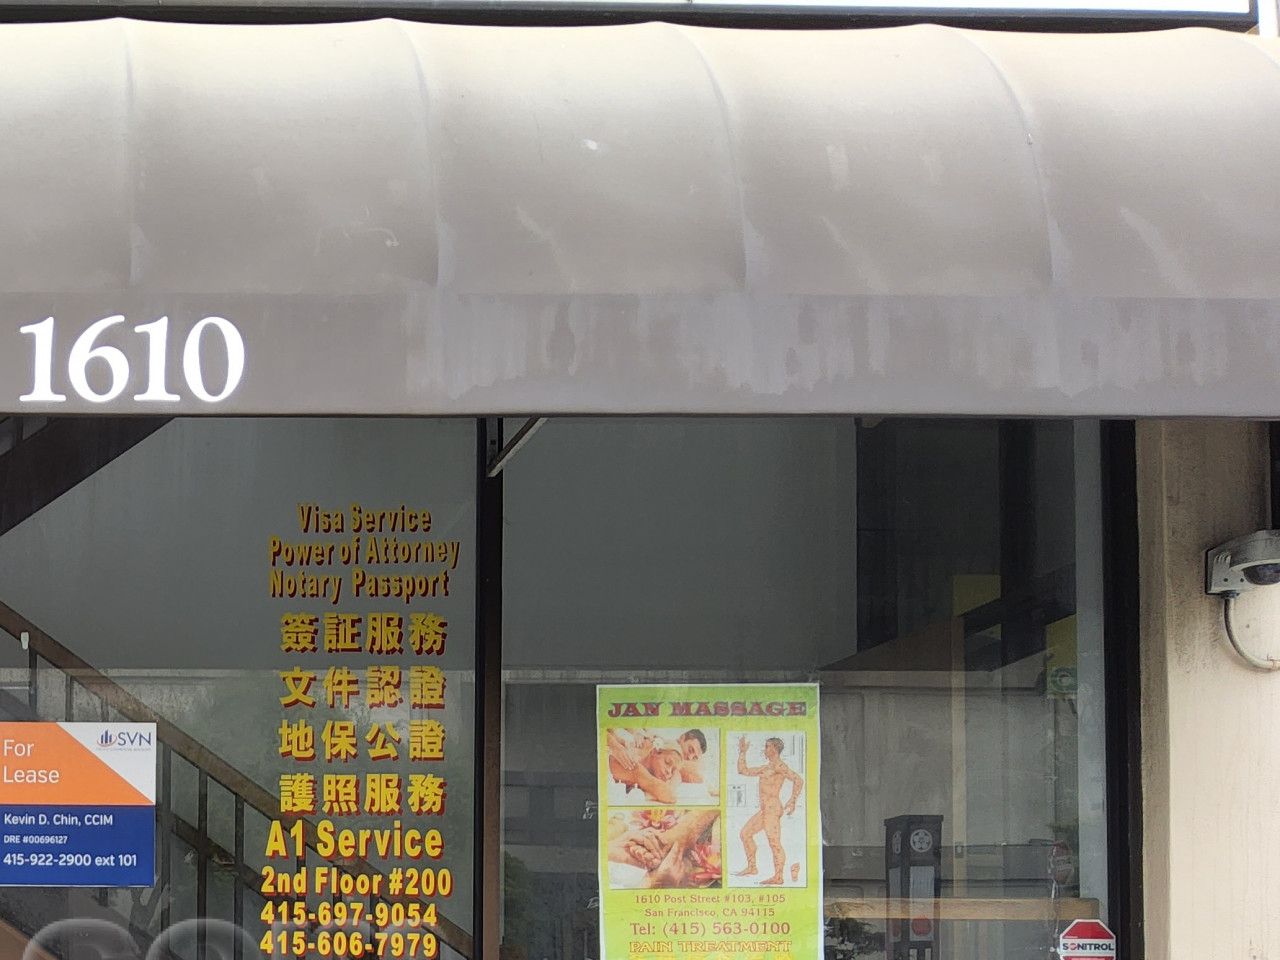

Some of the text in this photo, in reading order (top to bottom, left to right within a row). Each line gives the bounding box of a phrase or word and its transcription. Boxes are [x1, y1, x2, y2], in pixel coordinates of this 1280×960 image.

[19, 314, 245, 403] 1610
[297, 504, 432, 533] Visa Service
[270, 535, 461, 569] Power of Attorney
[271, 568, 450, 604] Notary Passport
[279, 665, 447, 709] 文件認證
[607, 701, 807, 718] JAN MASSAGE
[3, 739, 35, 757] For
[118, 732, 152, 747] SVN
[278, 718, 446, 762] 地保公證
[3, 766, 60, 784] Lease
[279, 773, 448, 817] 護照服務
[4, 814, 113, 827] Kevin D. Chin, CCIM
[4, 835, 21, 844] DRE
[265, 819, 445, 860] A1 Service
[3, 854, 137, 867] 415-922-2900 ext 101
[261, 866, 453, 897] 2nd Floor #200
[635, 895, 661, 904] 1610
[664, 895, 688, 904] Post
[690, 895, 721, 904] Street
[758, 894, 786, 904] #105
[260, 901, 438, 928] 415-697-9054
[644, 908, 664, 917] San
[722, 908, 738, 917] CA
[741, 908, 775, 917] 94115
[630, 922, 790, 937] Tel: (415) 563-0100
[259, 930, 438, 958] 415-606-7979
[629, 940, 792, 953] PAIN TREATMENT
[1062, 943, 1114, 951] SONITROL
